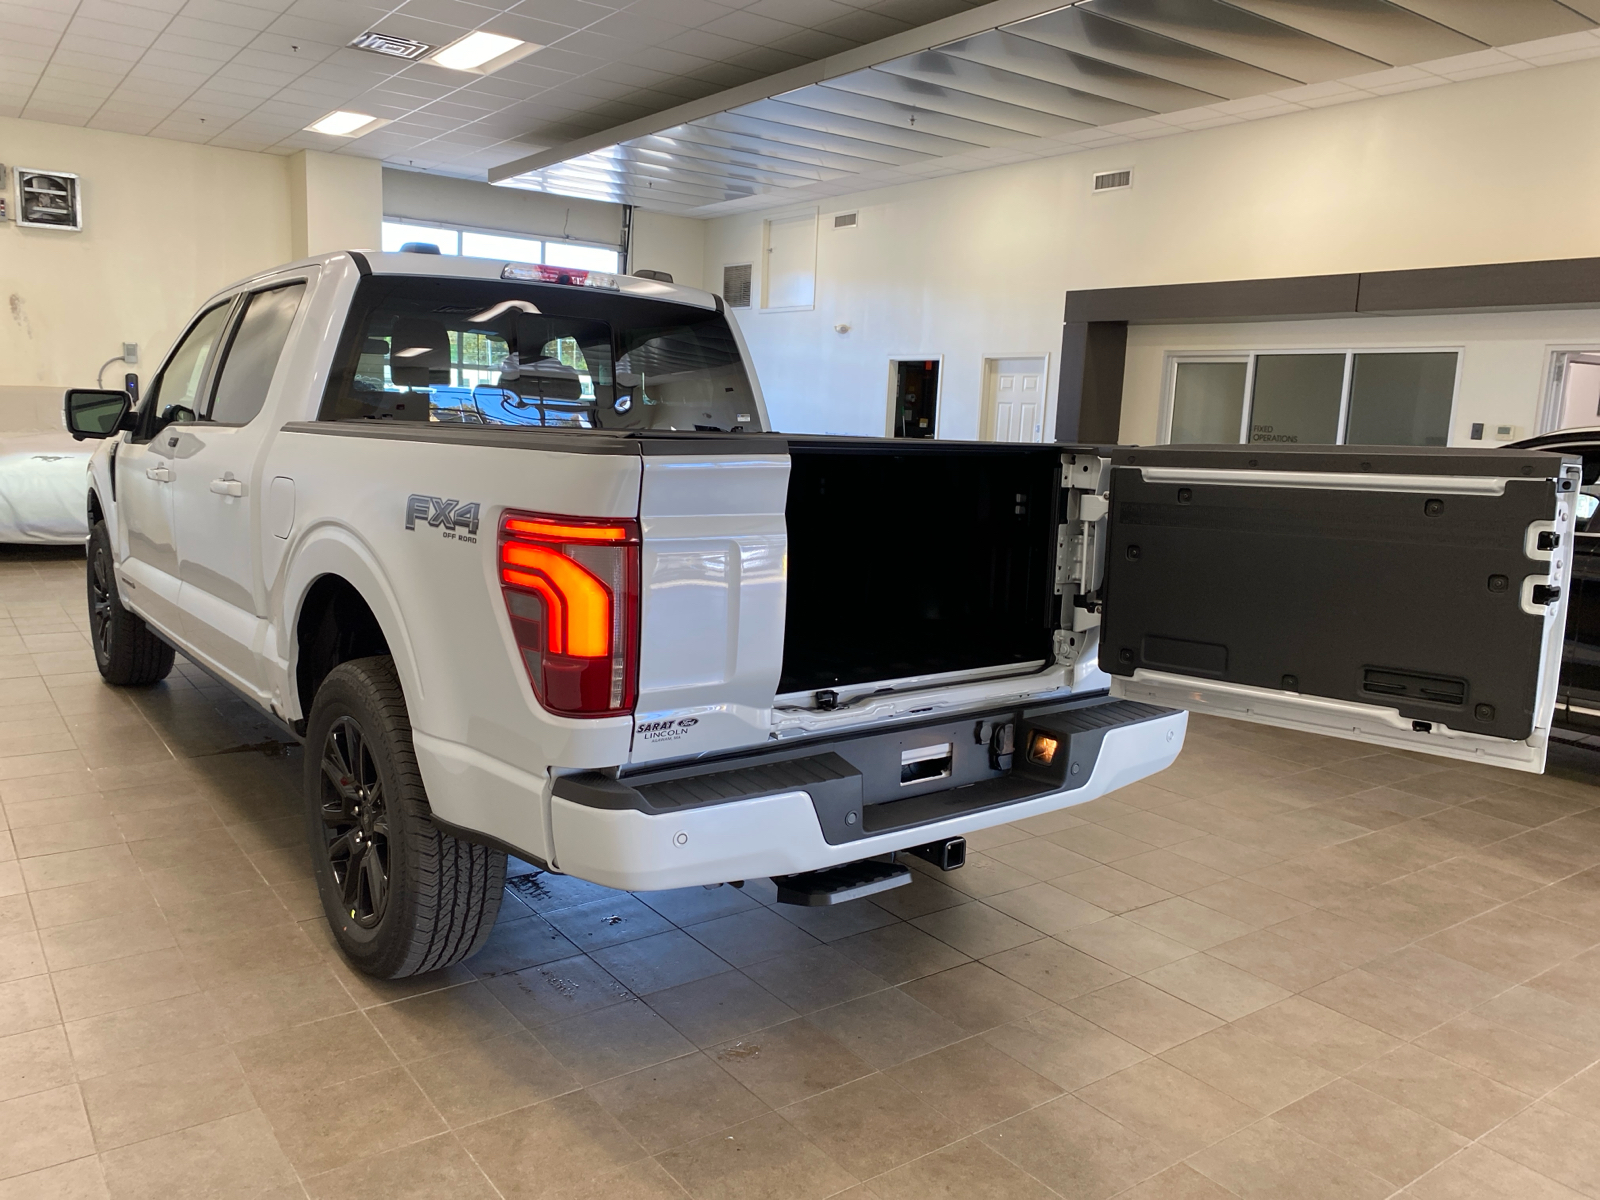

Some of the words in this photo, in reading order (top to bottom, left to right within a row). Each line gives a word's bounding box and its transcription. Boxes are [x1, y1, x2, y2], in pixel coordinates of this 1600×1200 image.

[1254, 424, 1274, 433] FIXED
[1253, 433, 1298, 443] OPERATIONS
[405, 493, 481, 535] FX4
[443, 532, 456, 540] OFF
[458, 534, 477, 544] ROAD
[636, 720, 676, 733] SARAT
[644, 728, 688, 739] LINCOLN
